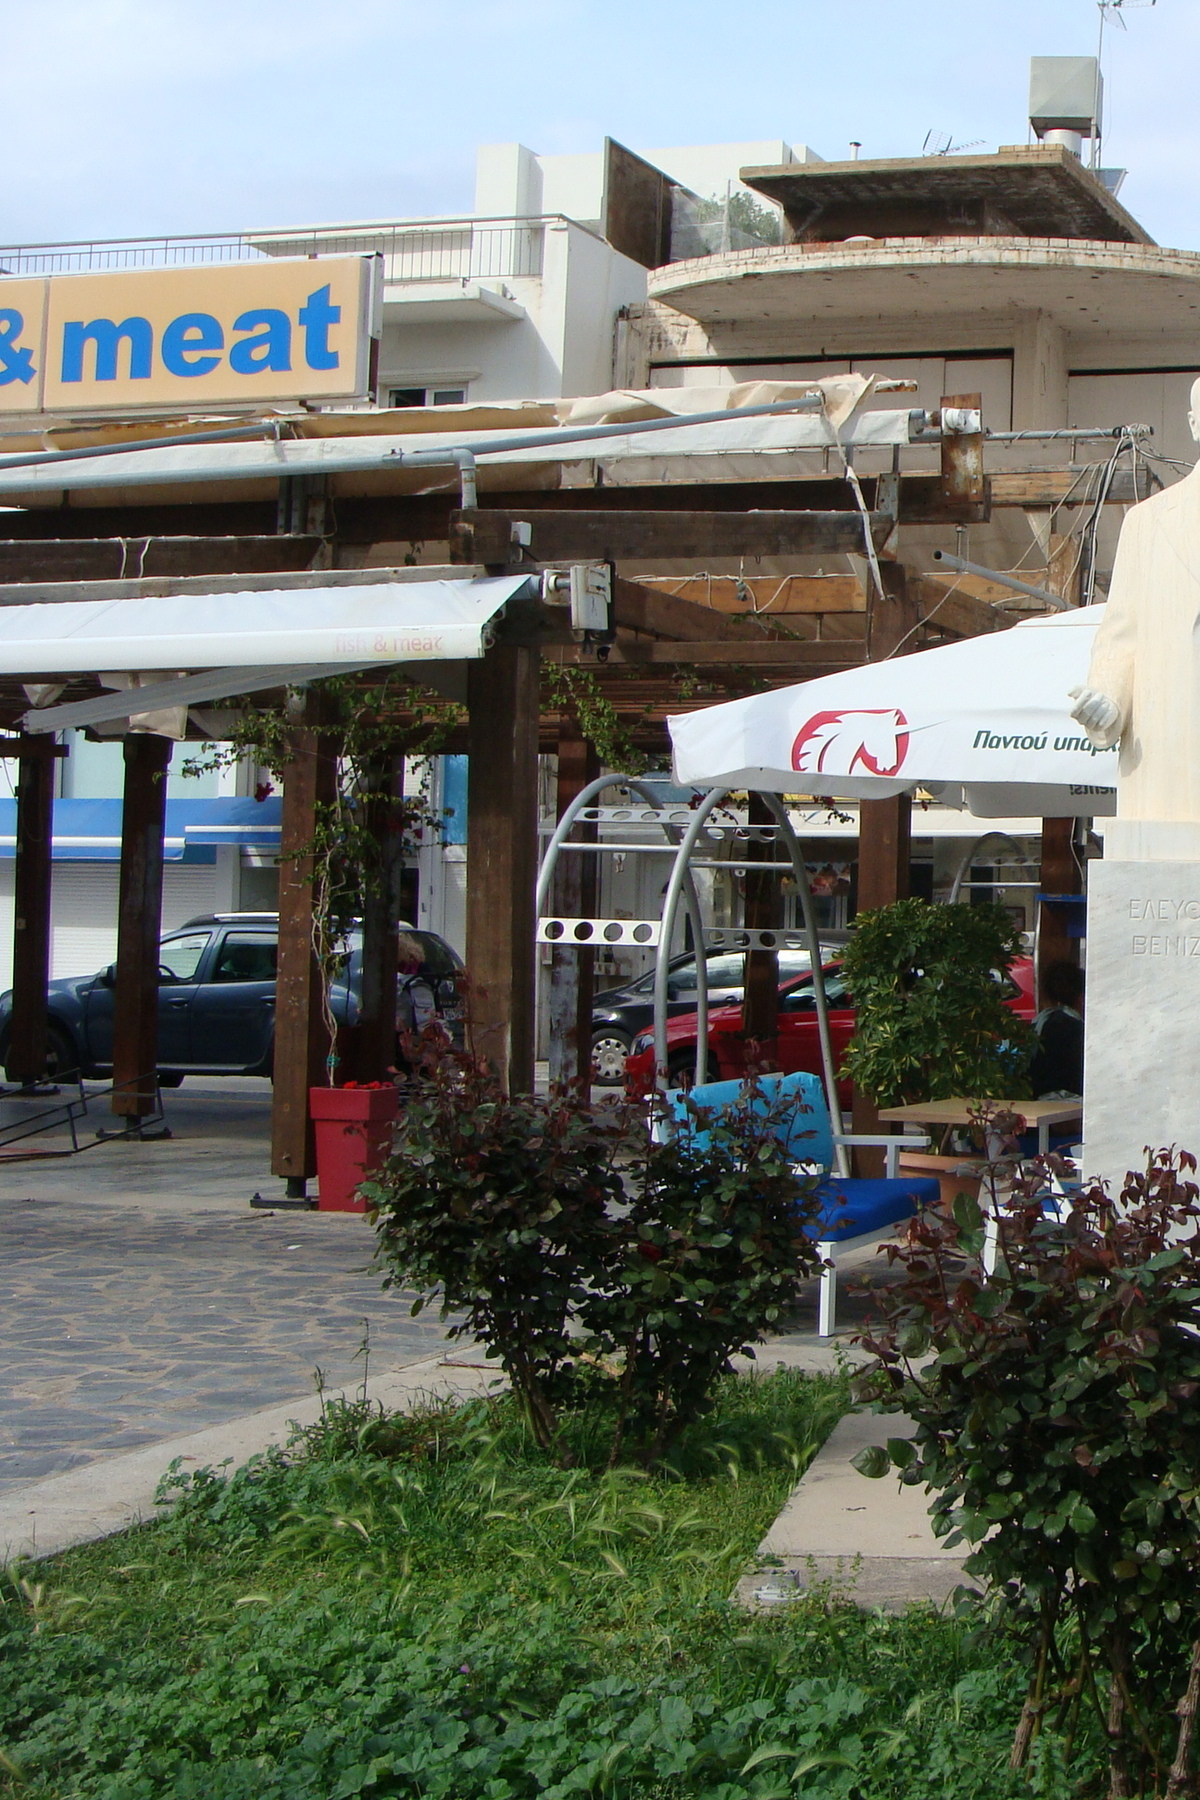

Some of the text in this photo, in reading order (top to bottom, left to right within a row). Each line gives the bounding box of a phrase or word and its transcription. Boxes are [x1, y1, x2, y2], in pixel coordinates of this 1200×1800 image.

[0, 283, 341, 387] & meat
[335, 634, 443, 653] fish & meat
[973, 730, 1048, 750] Παντού
